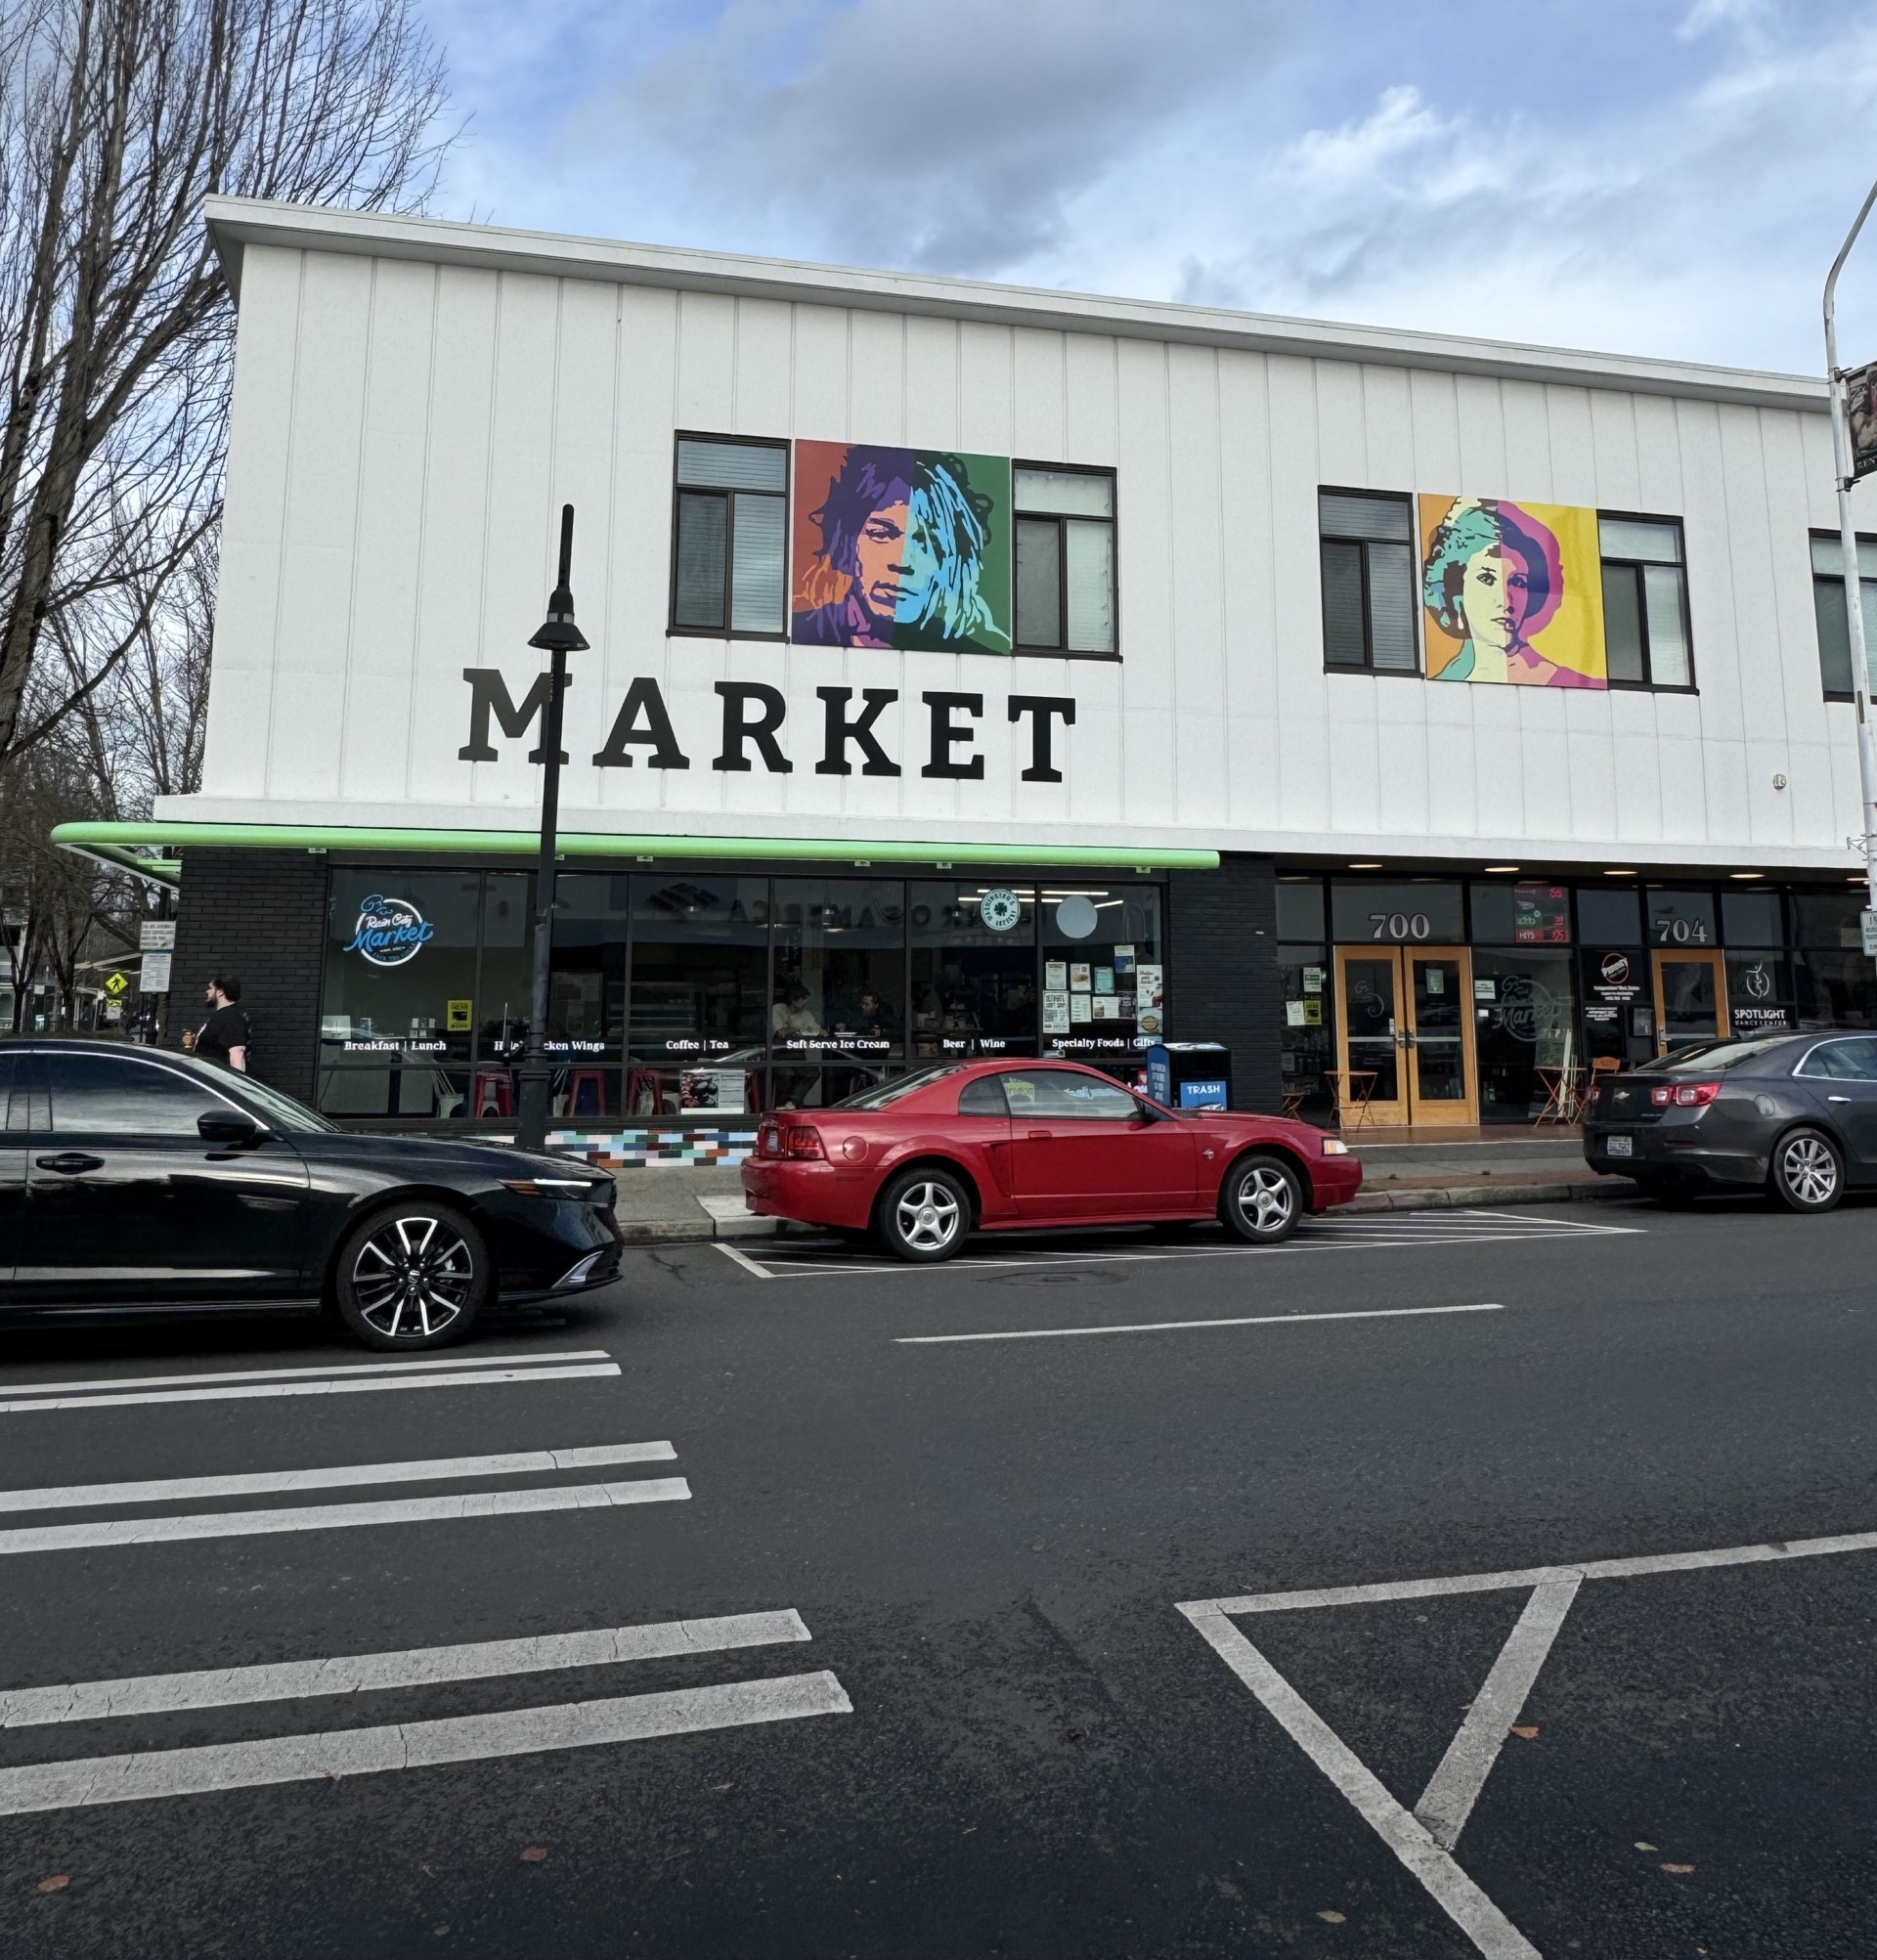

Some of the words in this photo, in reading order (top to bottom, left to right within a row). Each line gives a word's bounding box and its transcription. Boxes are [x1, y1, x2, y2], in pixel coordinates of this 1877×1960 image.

[458, 668, 1075, 782] MARKET
[366, 916, 391, 930] Rain
[392, 913, 414, 928] City
[1369, 913, 1430, 938] 700
[343, 921, 434, 952] Market
[1656, 919, 1708, 942] 704
[1734, 1009, 1786, 1020] SPOTLIGHT
[344, 1041, 399, 1051] Breakfast
[412, 1040, 447, 1051] Lunch
[571, 1040, 605, 1052] Wings
[666, 1039, 700, 1050] Coffee
[709, 1039, 729, 1049] Tea
[786, 1039, 807, 1049] Soft
[808, 1039, 838, 1049] Serve
[840, 1039, 855, 1049] Ice
[856, 1039, 891, 1049] Cream
[942, 1038, 966, 1049] Beer
[980, 1038, 1006, 1049] Wine
[1052, 1038, 1095, 1050] Specialty
[1097, 1038, 1125, 1048] Foods
[1187, 1084, 1220, 1095] TRASH
